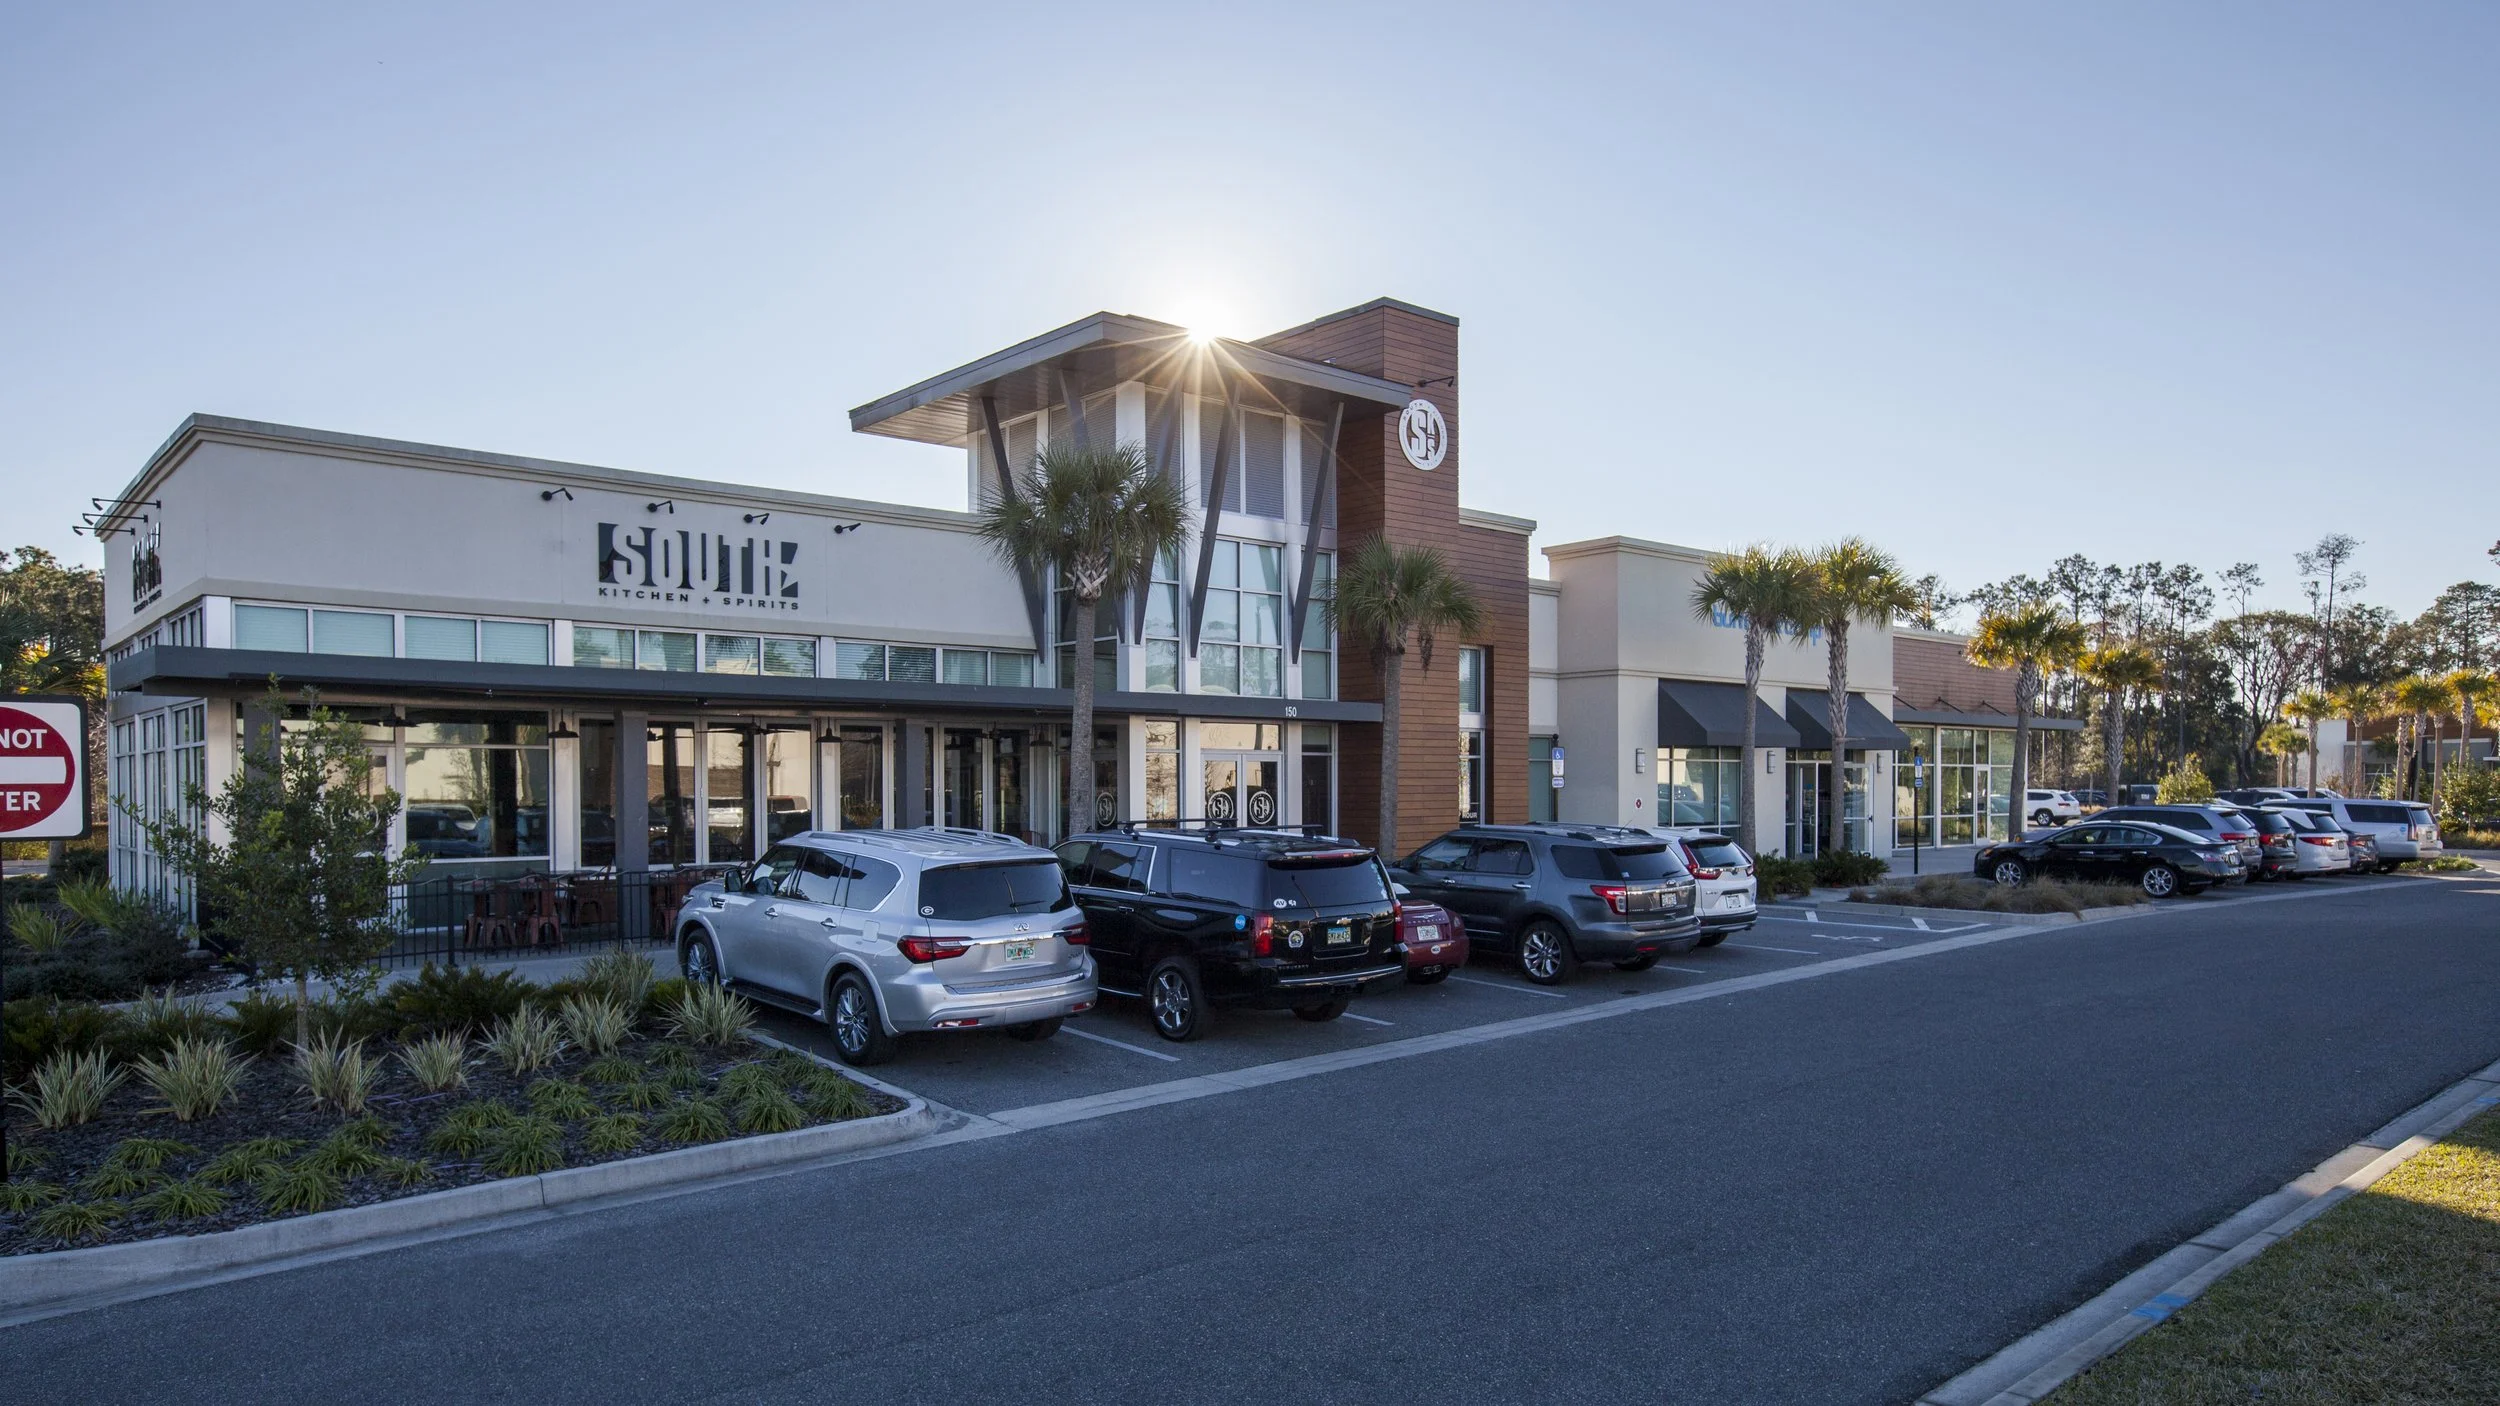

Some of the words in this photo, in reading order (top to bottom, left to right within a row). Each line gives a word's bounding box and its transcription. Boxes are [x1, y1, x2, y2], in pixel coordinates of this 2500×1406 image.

[598, 522, 798, 598] SOUTH
[599, 587, 689, 602] KITCHEN
[723, 597, 799, 610] SPIRITS
[1285, 706, 1297, 717] 150
[0, 728, 48, 749] NOT
[0, 791, 41, 812] ER
